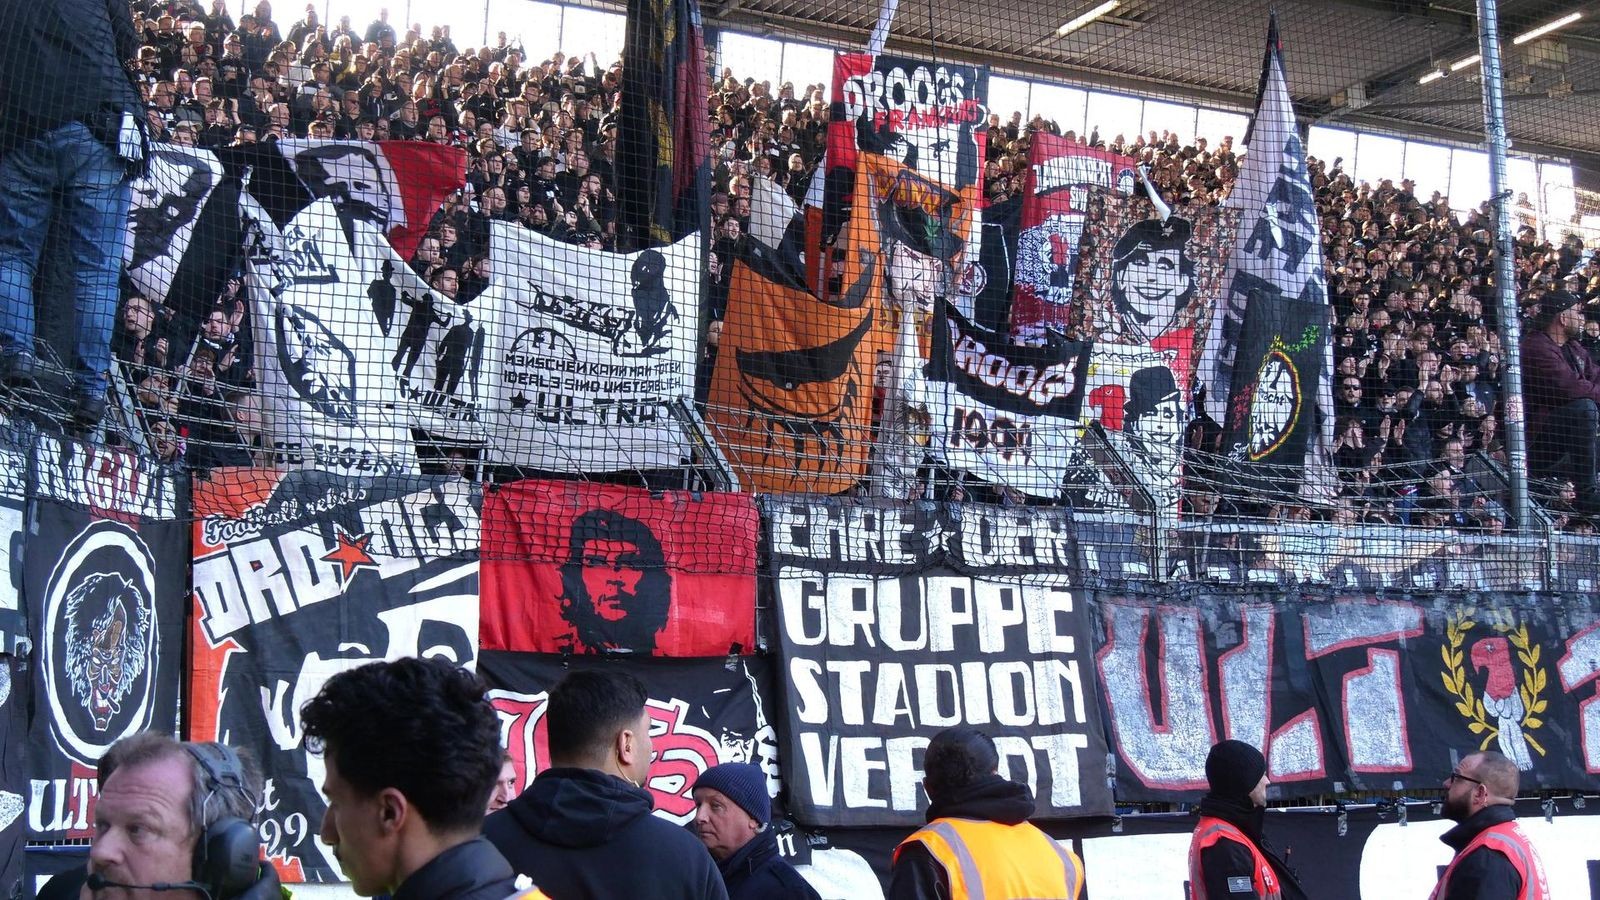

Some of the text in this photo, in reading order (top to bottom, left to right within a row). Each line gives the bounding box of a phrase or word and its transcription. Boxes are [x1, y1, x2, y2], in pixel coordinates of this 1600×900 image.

[843, 66, 964, 121] DROOGS
[773, 502, 1070, 568] EHRE DER
[779, 565, 1076, 654] GRUPPE
[790, 657, 1086, 729] STADION
[800, 732, 1088, 811] VEROT
